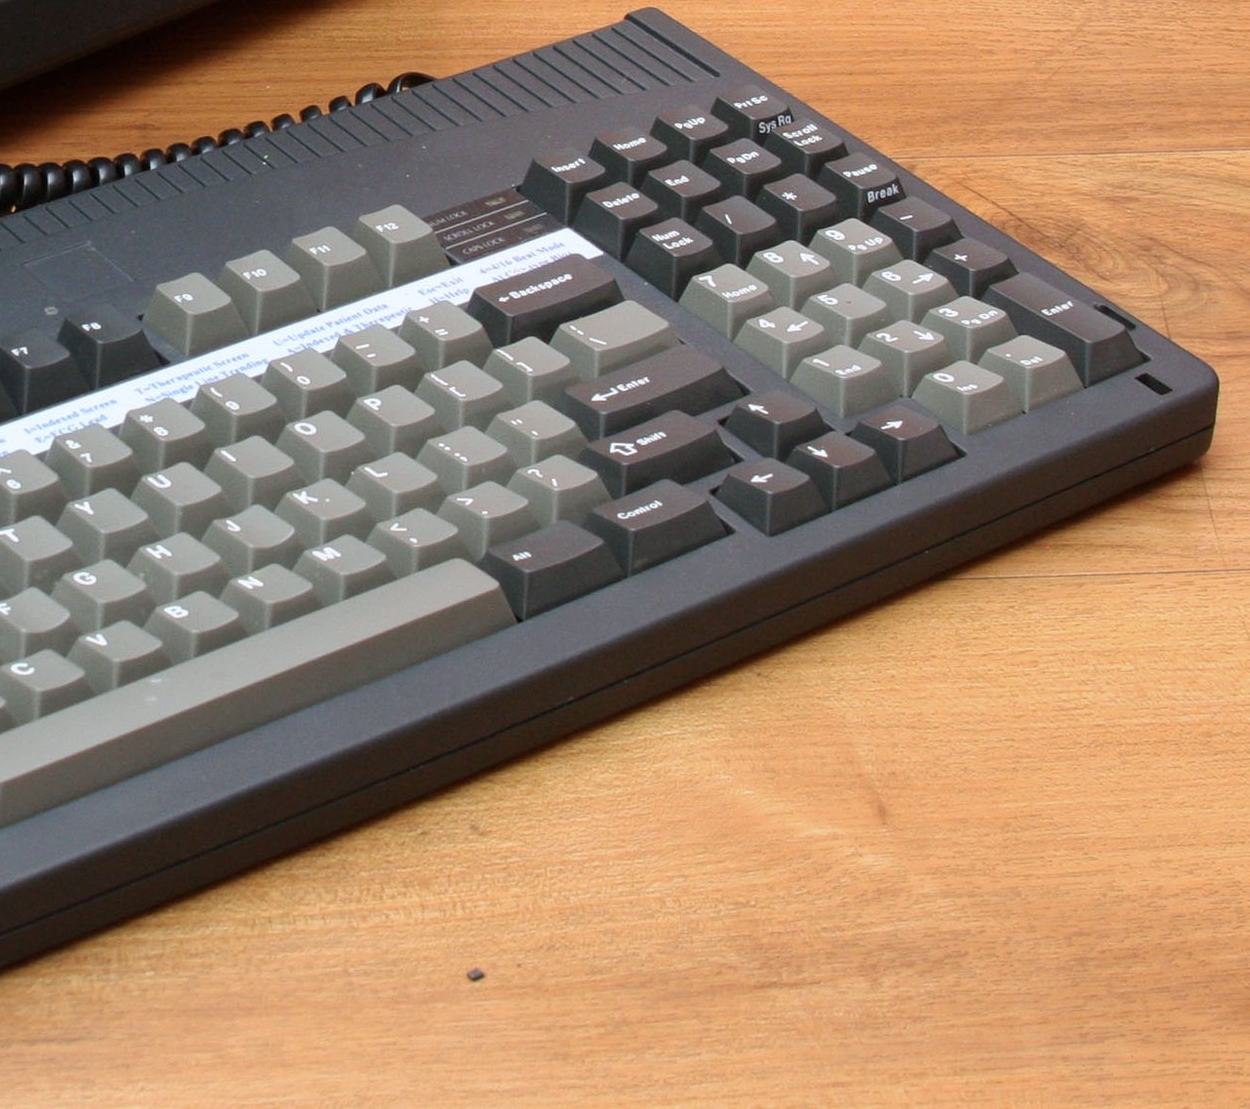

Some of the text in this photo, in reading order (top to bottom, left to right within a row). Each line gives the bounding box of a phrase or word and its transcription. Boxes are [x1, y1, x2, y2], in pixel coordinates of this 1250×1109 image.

[674, 116, 706, 130] PgUp
[758, 121, 777, 134] Sys
[782, 123, 819, 140] Scroll
[612, 137, 647, 151] Home
[793, 134, 824, 147] Lock
[726, 151, 760, 164] PgDn
[550, 157, 586, 173] Insert
[842, 163, 878, 178] Pause
[664, 175, 690, 187] End
[602, 192, 640, 208] Delete
[866, 183, 900, 203] Break
[375, 222, 399, 233] F12
[473, 220, 496, 234] LOCK
[652, 229, 680, 242] Num
[825, 229, 846, 241] 9
[309, 244, 331, 255] F11
[462, 236, 506, 256] CAPS LOCK
[663, 235, 695, 250] Lock
[512, 250, 537, 263] Beat
[536, 240, 566, 254] Mode
[763, 251, 784, 264] 8
[242, 268, 267, 280] F10
[698, 274, 717, 288] 7
[881, 271, 902, 282] 6
[509, 273, 573, 299] Backspace
[721, 284, 758, 299] Home
[173, 293, 194, 303] F9
[817, 294, 839, 306] 5
[938, 307, 959, 318] 3
[1041, 300, 1074, 316] Enter
[81, 322, 102, 332] F8
[273, 302, 389, 346] U=Update Patient Data
[758, 318, 776, 329] 4
[876, 332, 899, 343] 2
[11, 346, 29, 357] F7
[1019, 355, 1043, 366] Del
[134, 352, 249, 395] T=Therapeutic Screen
[932, 372, 955, 383] 0
[616, 376, 651, 393] Enter
[80, 398, 118, 414] Screen
[363, 398, 382, 411] P
[294, 422, 317, 436] O
[636, 431, 668, 447] Shift
[364, 466, 389, 478] L
[147, 474, 172, 489] U
[292, 490, 319, 505] K
[74, 501, 95, 515] Y
[616, 499, 663, 520] Control
[145, 544, 173, 560] H
[311, 546, 342, 562] M
[512, 551, 532, 561] Alt
[73, 571, 97, 586] G
[237, 576, 264, 590] N
[163, 605, 189, 619] B
[85, 633, 108, 646] V
[10, 662, 35, 676] C
